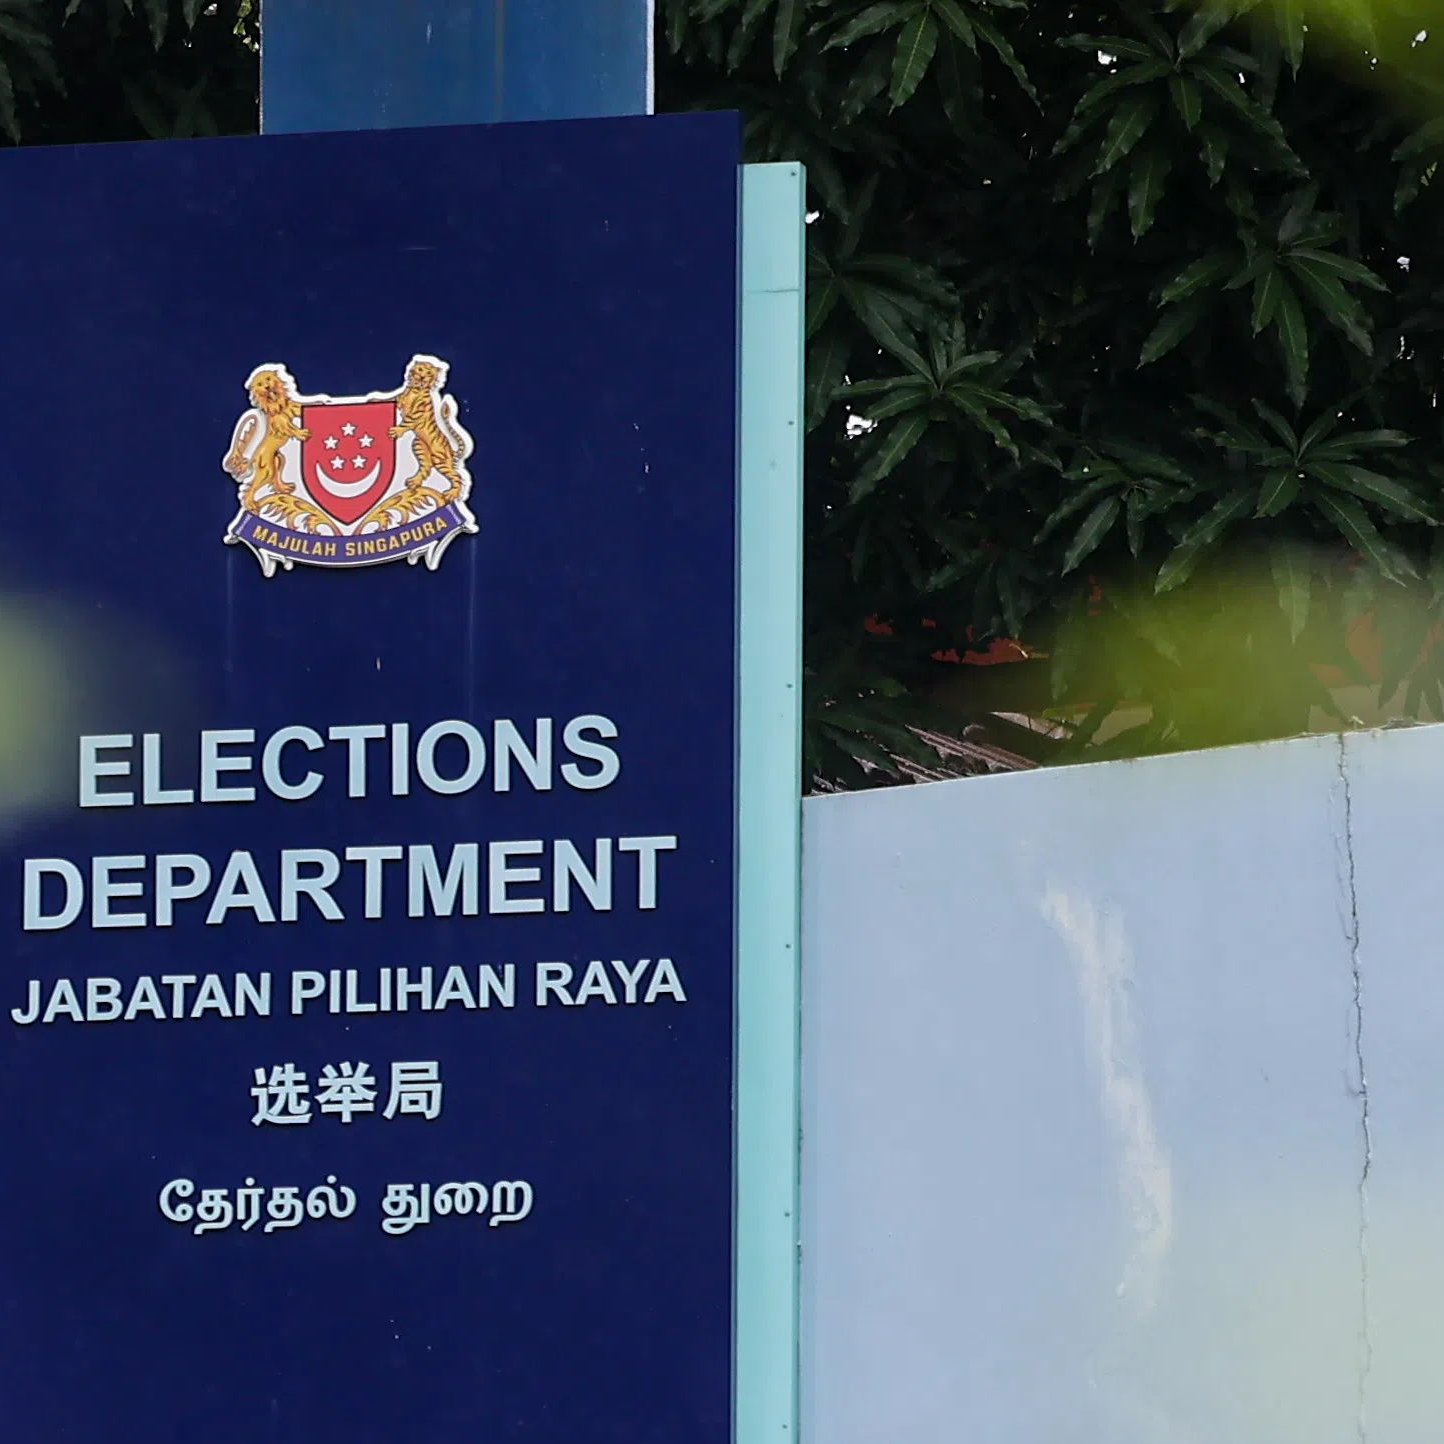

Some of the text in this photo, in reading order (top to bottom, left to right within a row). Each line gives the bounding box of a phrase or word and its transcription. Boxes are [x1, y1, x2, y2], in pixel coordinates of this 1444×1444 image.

[252, 516, 449, 557] MAJULAH SINGAPURA
[78, 714, 621, 808] ELECTIONS
[22, 835, 678, 931] DEPARTMENT
[10, 958, 688, 1024] JABATAN PILIHAN RAYA
[250, 1060, 444, 1126] 选举局
[159, 1174, 534, 1235] தேர்தல் துறை
